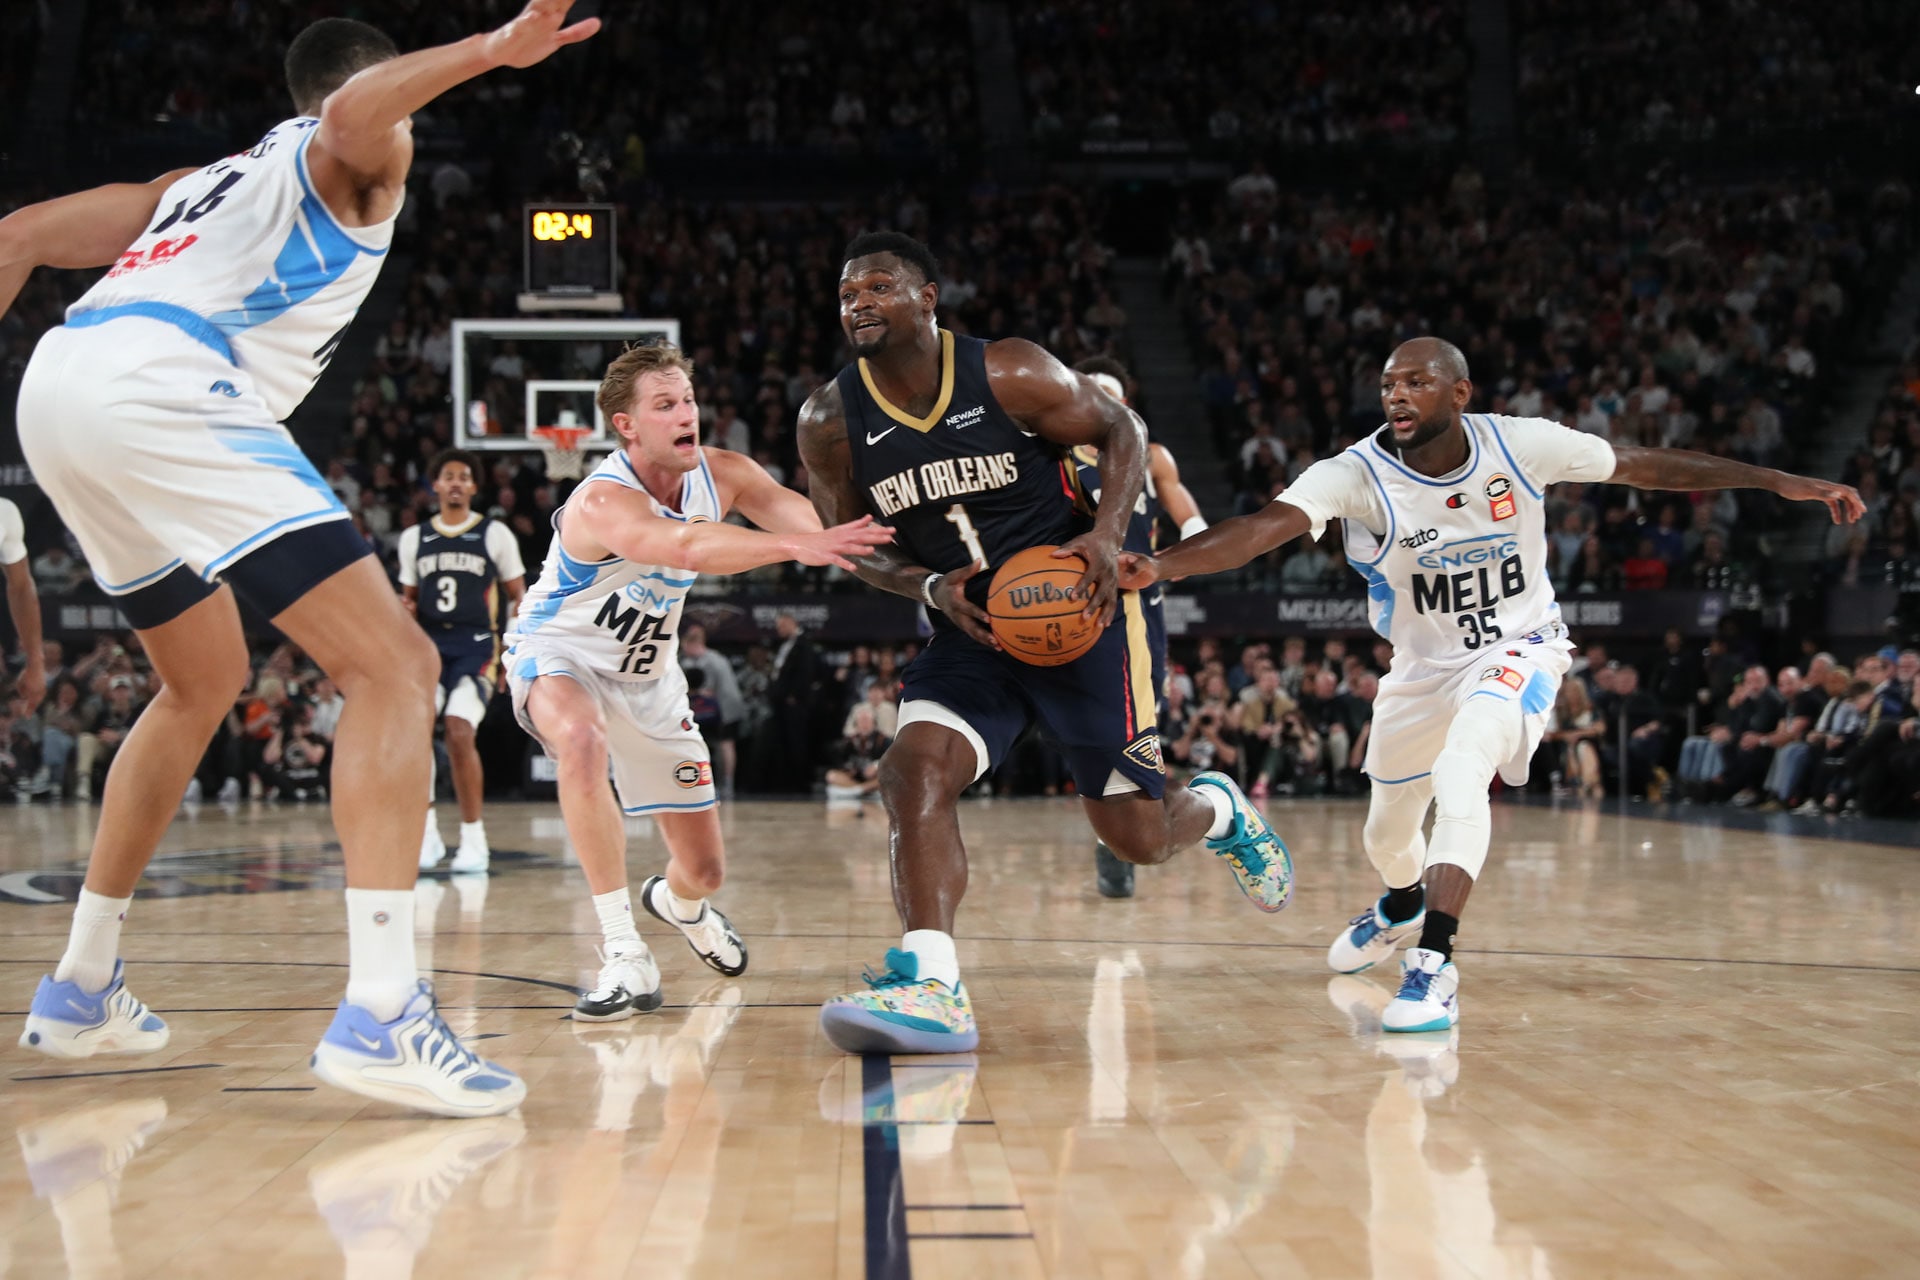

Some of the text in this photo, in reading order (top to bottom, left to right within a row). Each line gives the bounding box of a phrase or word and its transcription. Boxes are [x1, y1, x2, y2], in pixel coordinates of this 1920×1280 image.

[150, 170, 246, 235] 16
[945, 405, 986, 426] NEWAGE
[955, 416, 981, 430] GARAGE
[869, 452, 1019, 517] NEW ORLEANS
[944, 503, 990, 572] 1
[436, 576, 457, 612] 3
[1411, 553, 1526, 615] MELB
[1457, 608, 1502, 650] 35
[619, 644, 658, 675] 12
